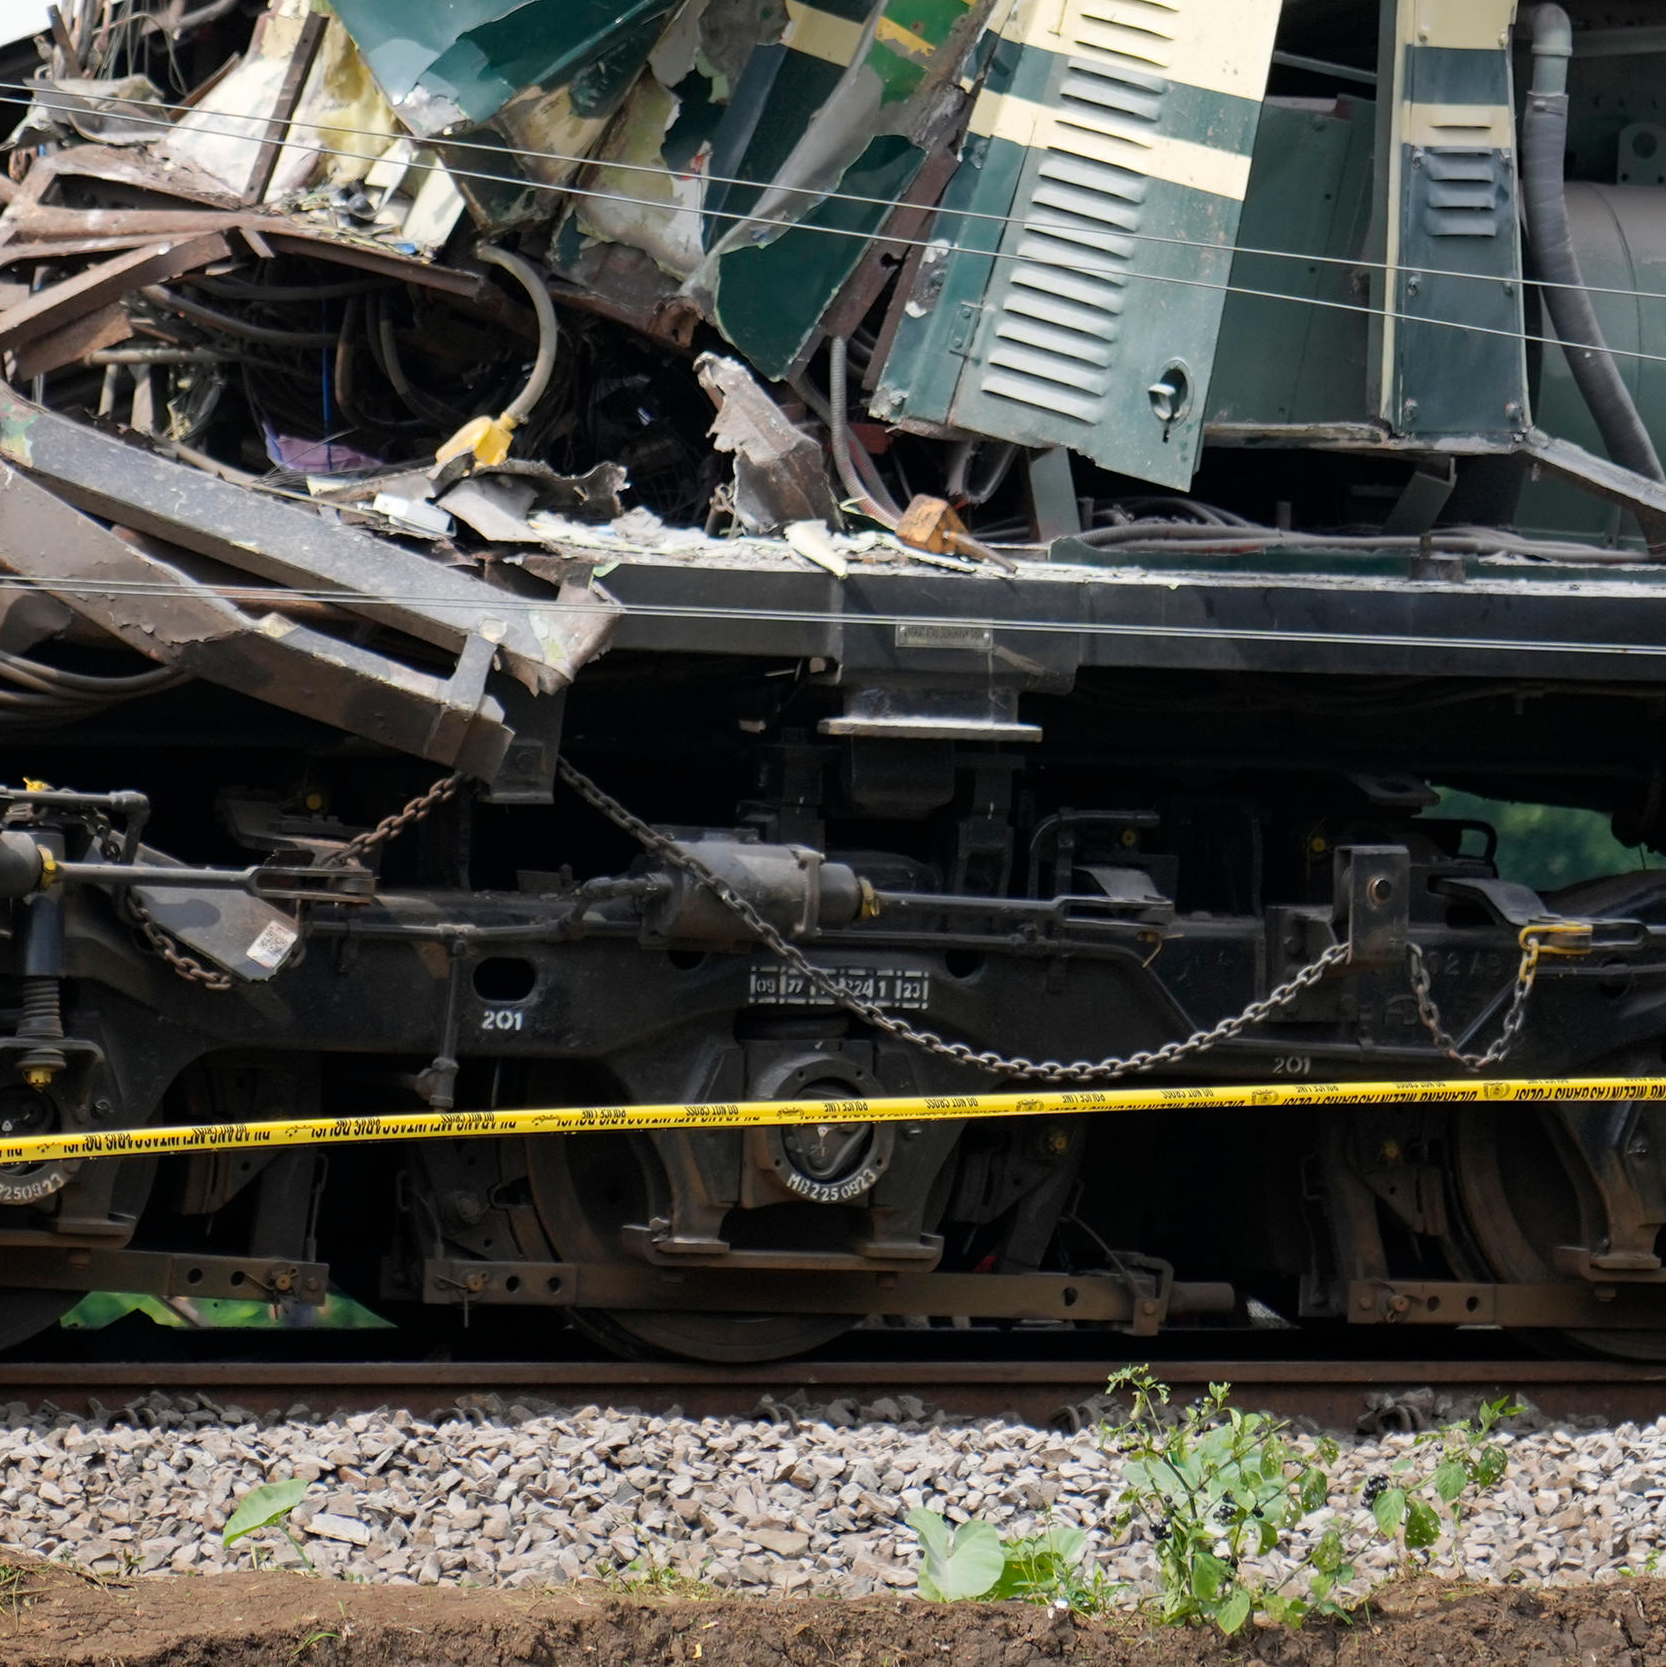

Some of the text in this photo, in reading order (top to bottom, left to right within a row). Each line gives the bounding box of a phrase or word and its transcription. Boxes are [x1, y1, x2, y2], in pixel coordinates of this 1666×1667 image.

[903, 983, 921, 998] 23
[482, 1011, 523, 1031] 201
[1272, 1057, 1311, 1075] 201
